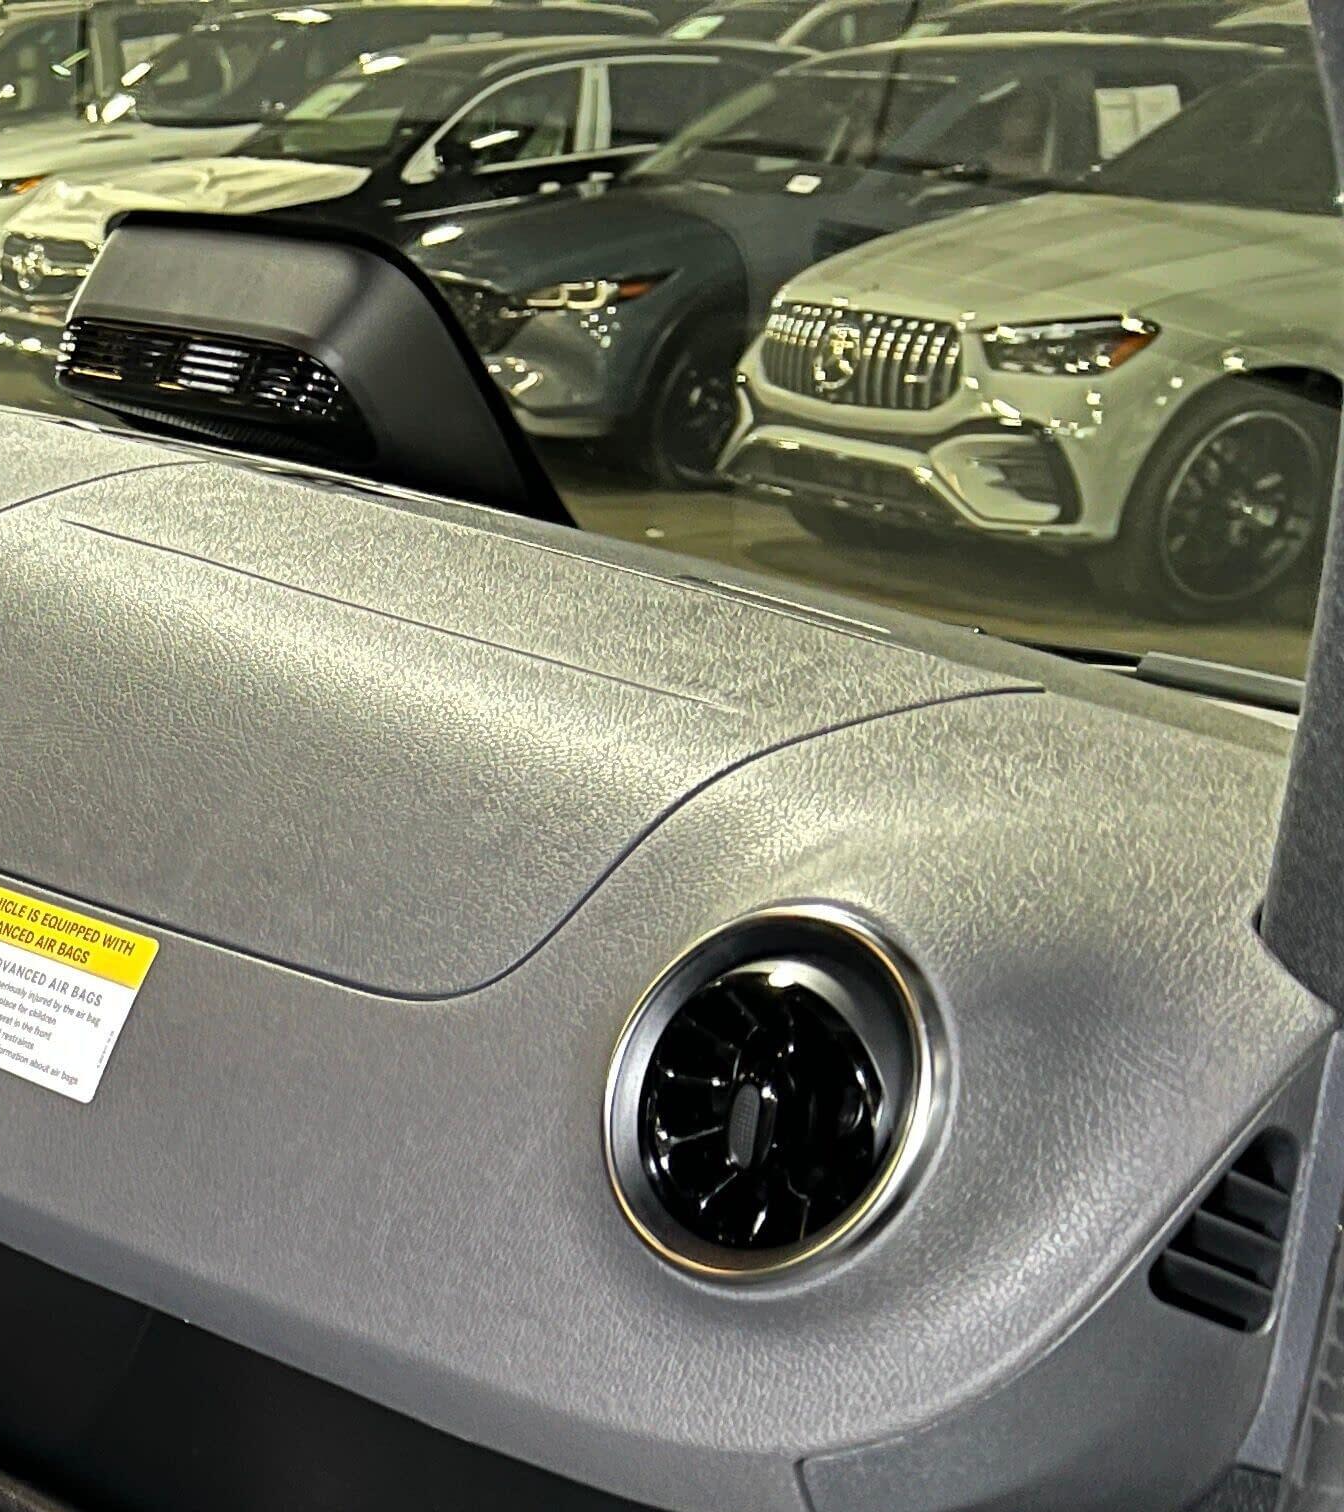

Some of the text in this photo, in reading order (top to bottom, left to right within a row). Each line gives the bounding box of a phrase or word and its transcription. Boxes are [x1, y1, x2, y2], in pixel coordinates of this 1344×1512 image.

[27, 908, 41, 923] IS
[41, 913, 101, 943] EQUIPPED
[102, 933, 136, 956] WITH
[35, 935, 56, 953] AIR
[57, 942, 90, 964] BAGS
[48, 977, 70, 995] AIR
[71, 985, 103, 1007] BAGS
